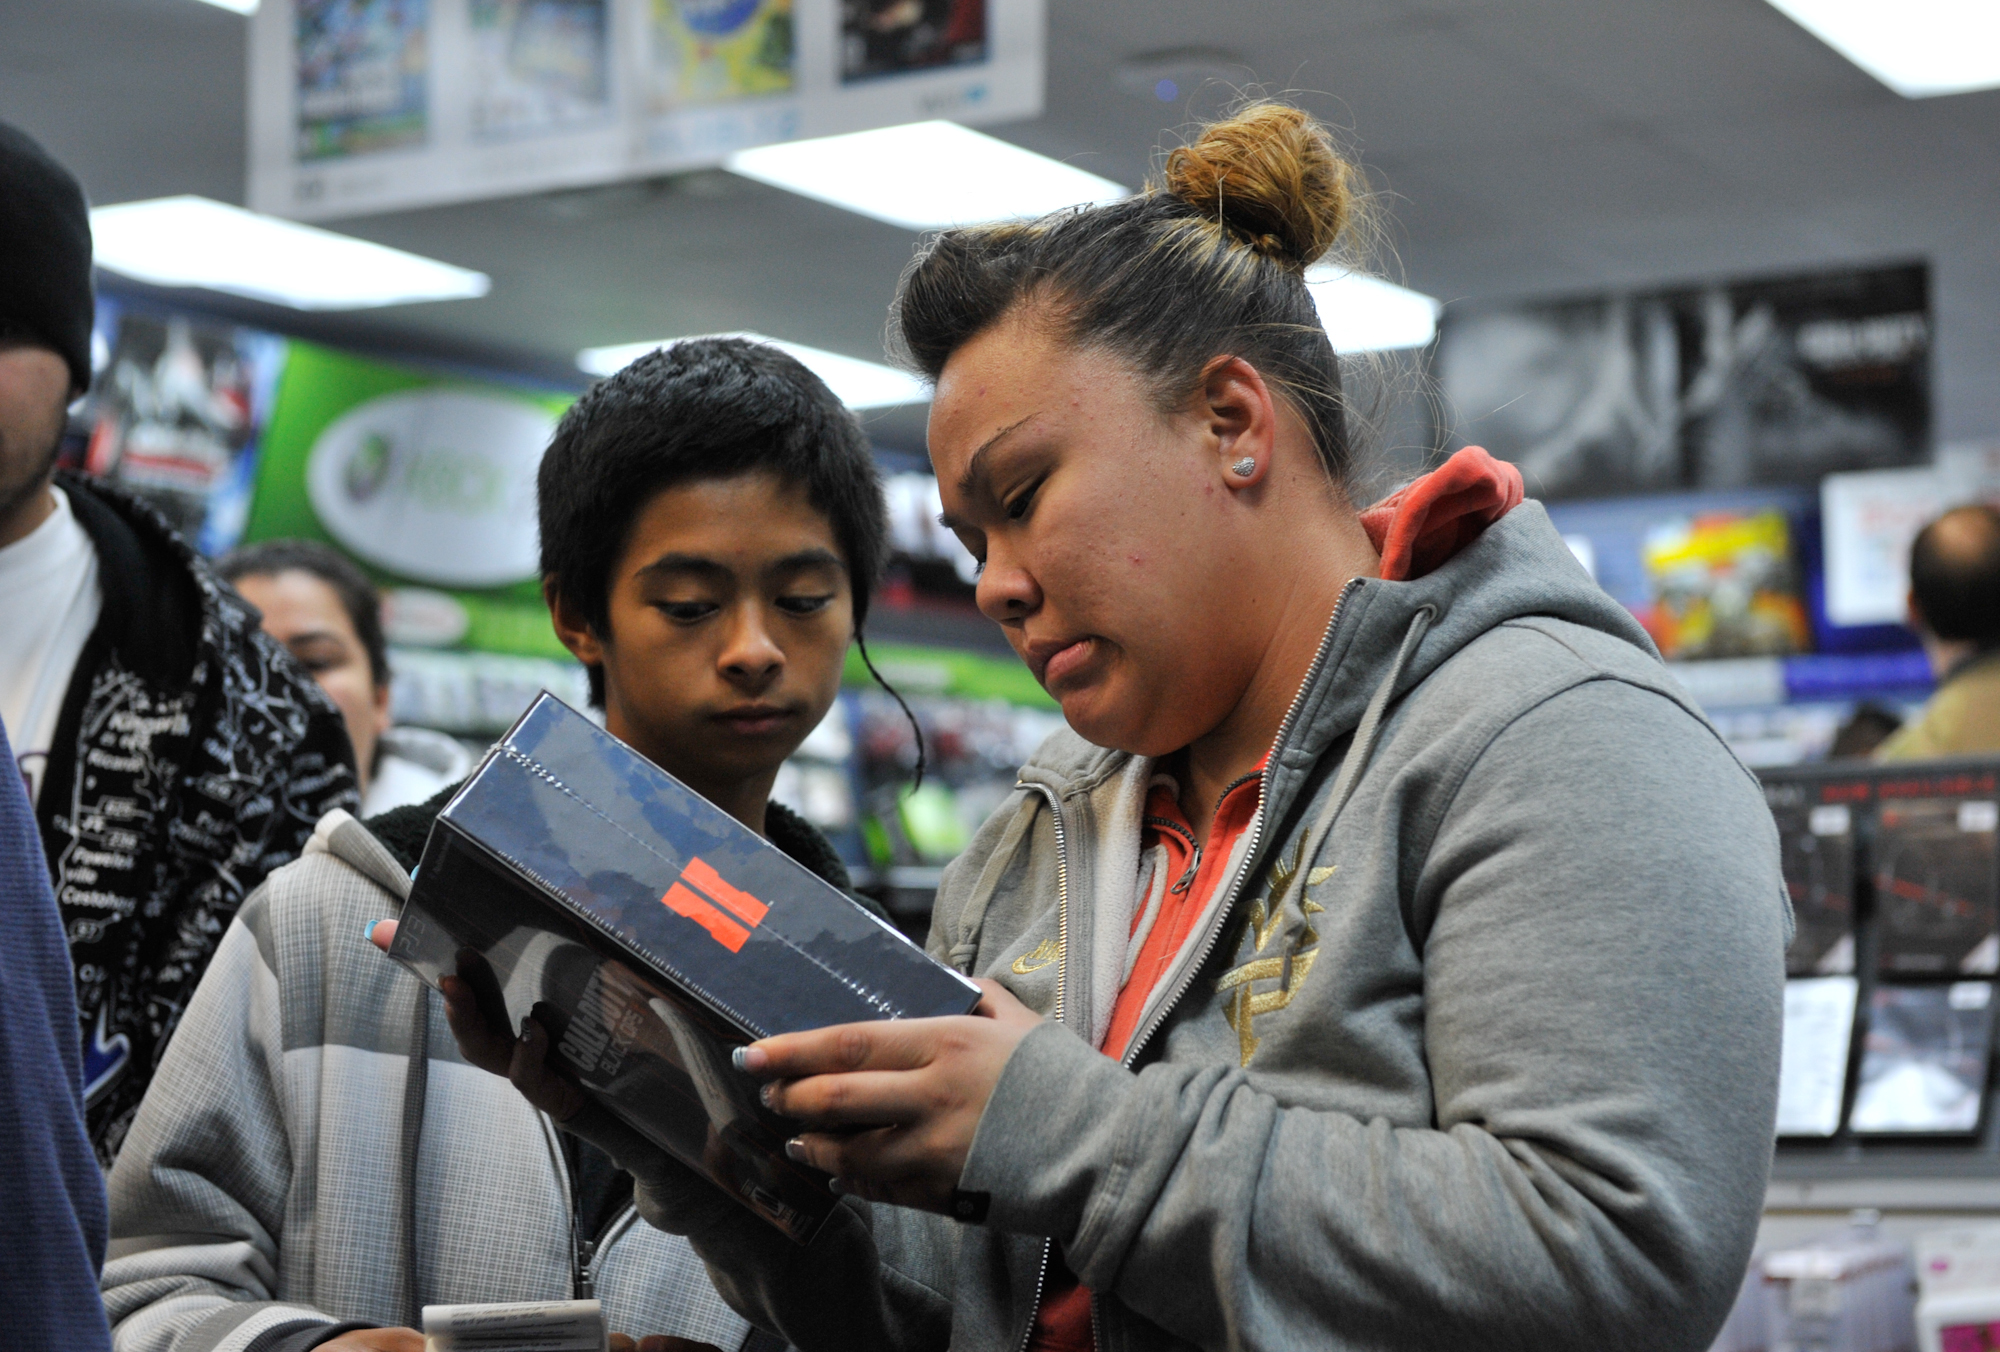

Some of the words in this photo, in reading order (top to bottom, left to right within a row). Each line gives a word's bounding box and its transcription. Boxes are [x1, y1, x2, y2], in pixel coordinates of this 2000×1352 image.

[399, 914, 425, 957] PS3
[1029, 938, 1060, 960] NIK
[577, 964, 632, 1032] DUTY
[558, 1015, 609, 1072] CALL
[600, 1032, 632, 1076] BLACK
[620, 1009, 644, 1038] OPS
